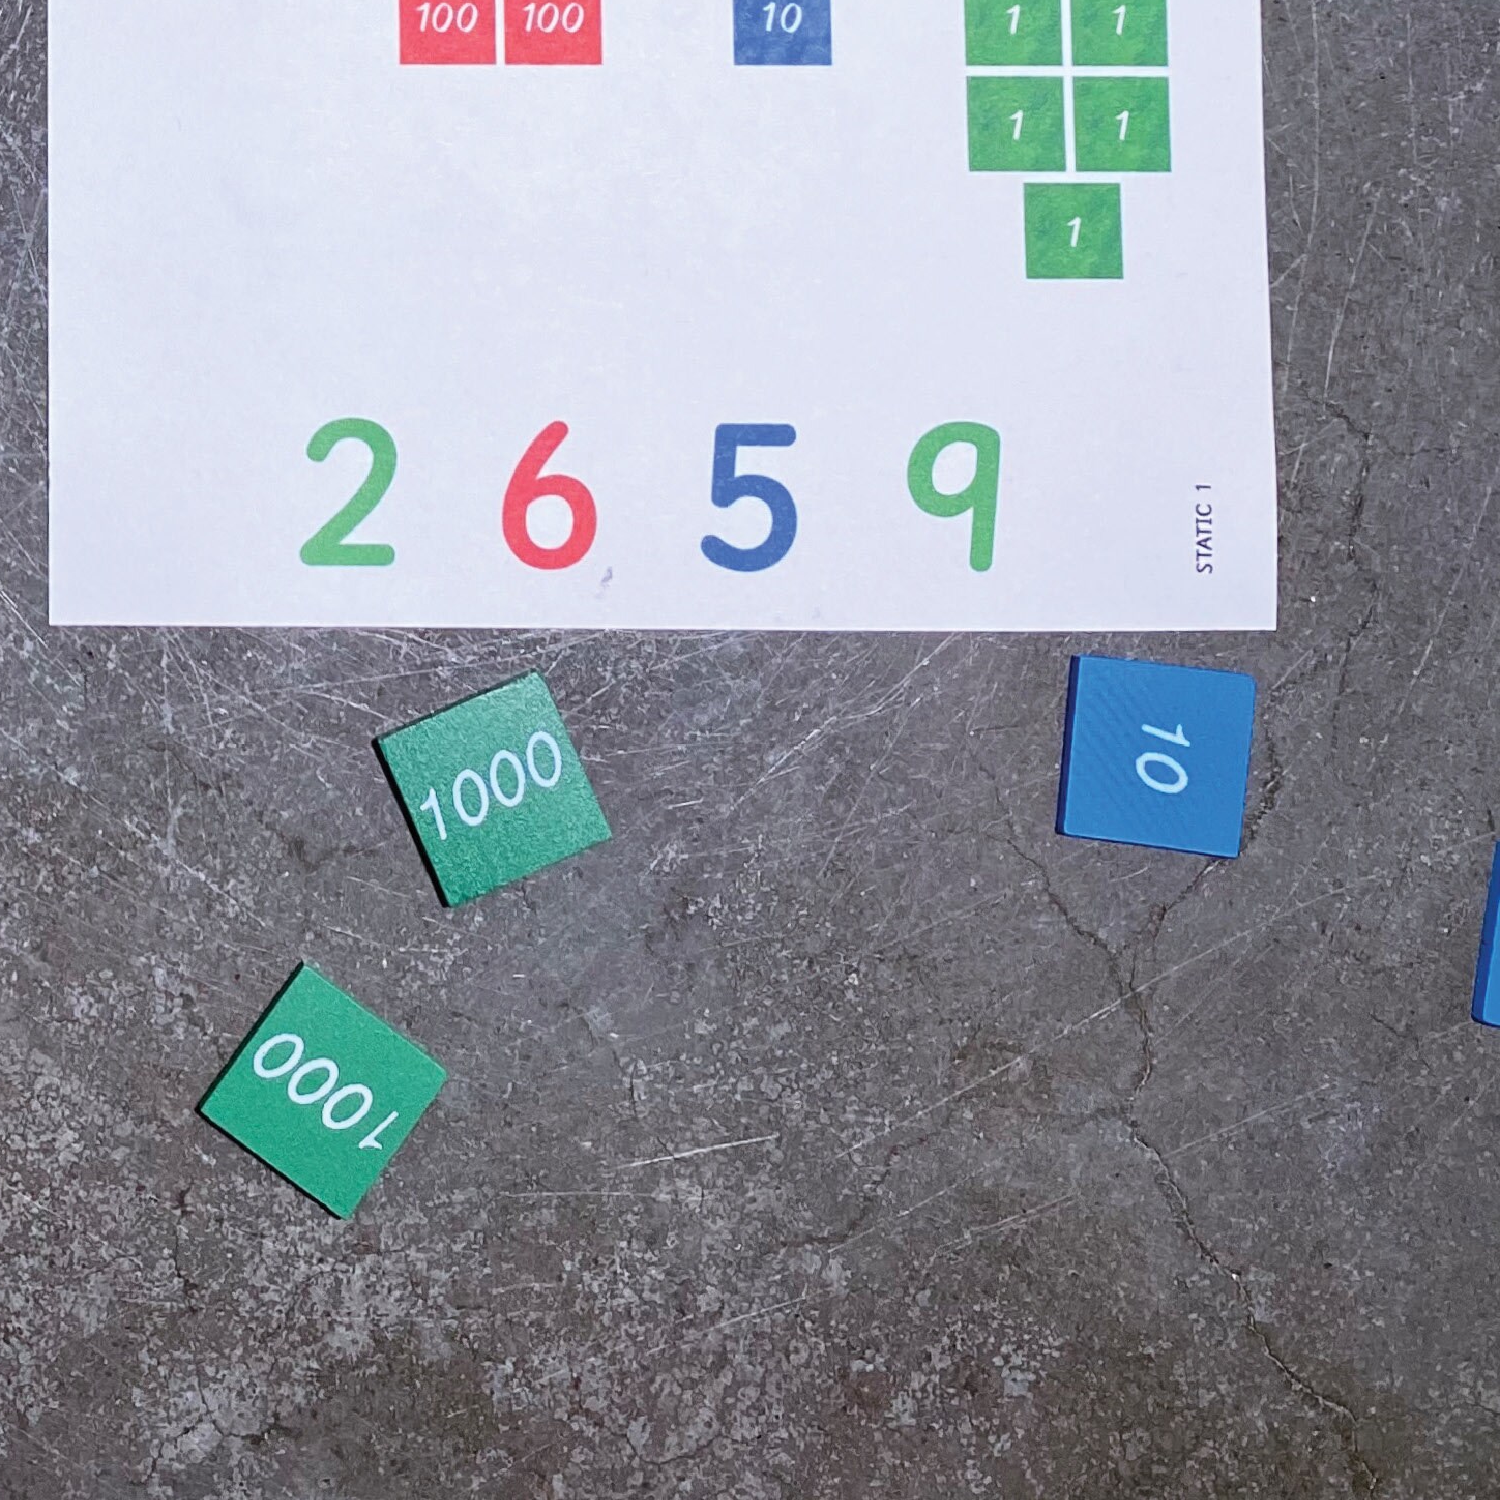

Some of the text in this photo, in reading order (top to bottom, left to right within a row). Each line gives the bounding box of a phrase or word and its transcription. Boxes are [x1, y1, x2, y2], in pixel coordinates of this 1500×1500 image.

[417, 2, 584, 33] 100 100
[763, 2, 803, 34] 10
[1006, 4, 1126, 36] 1 1
[1009, 109, 1130, 141] 1 1
[1067, 216, 1082, 248] 1
[1194, 482, 1214, 575] STATIC 1
[1136, 725, 1189, 793] 10
[418, 729, 565, 842] 1000
[251, 1032, 406, 1152] 1000
